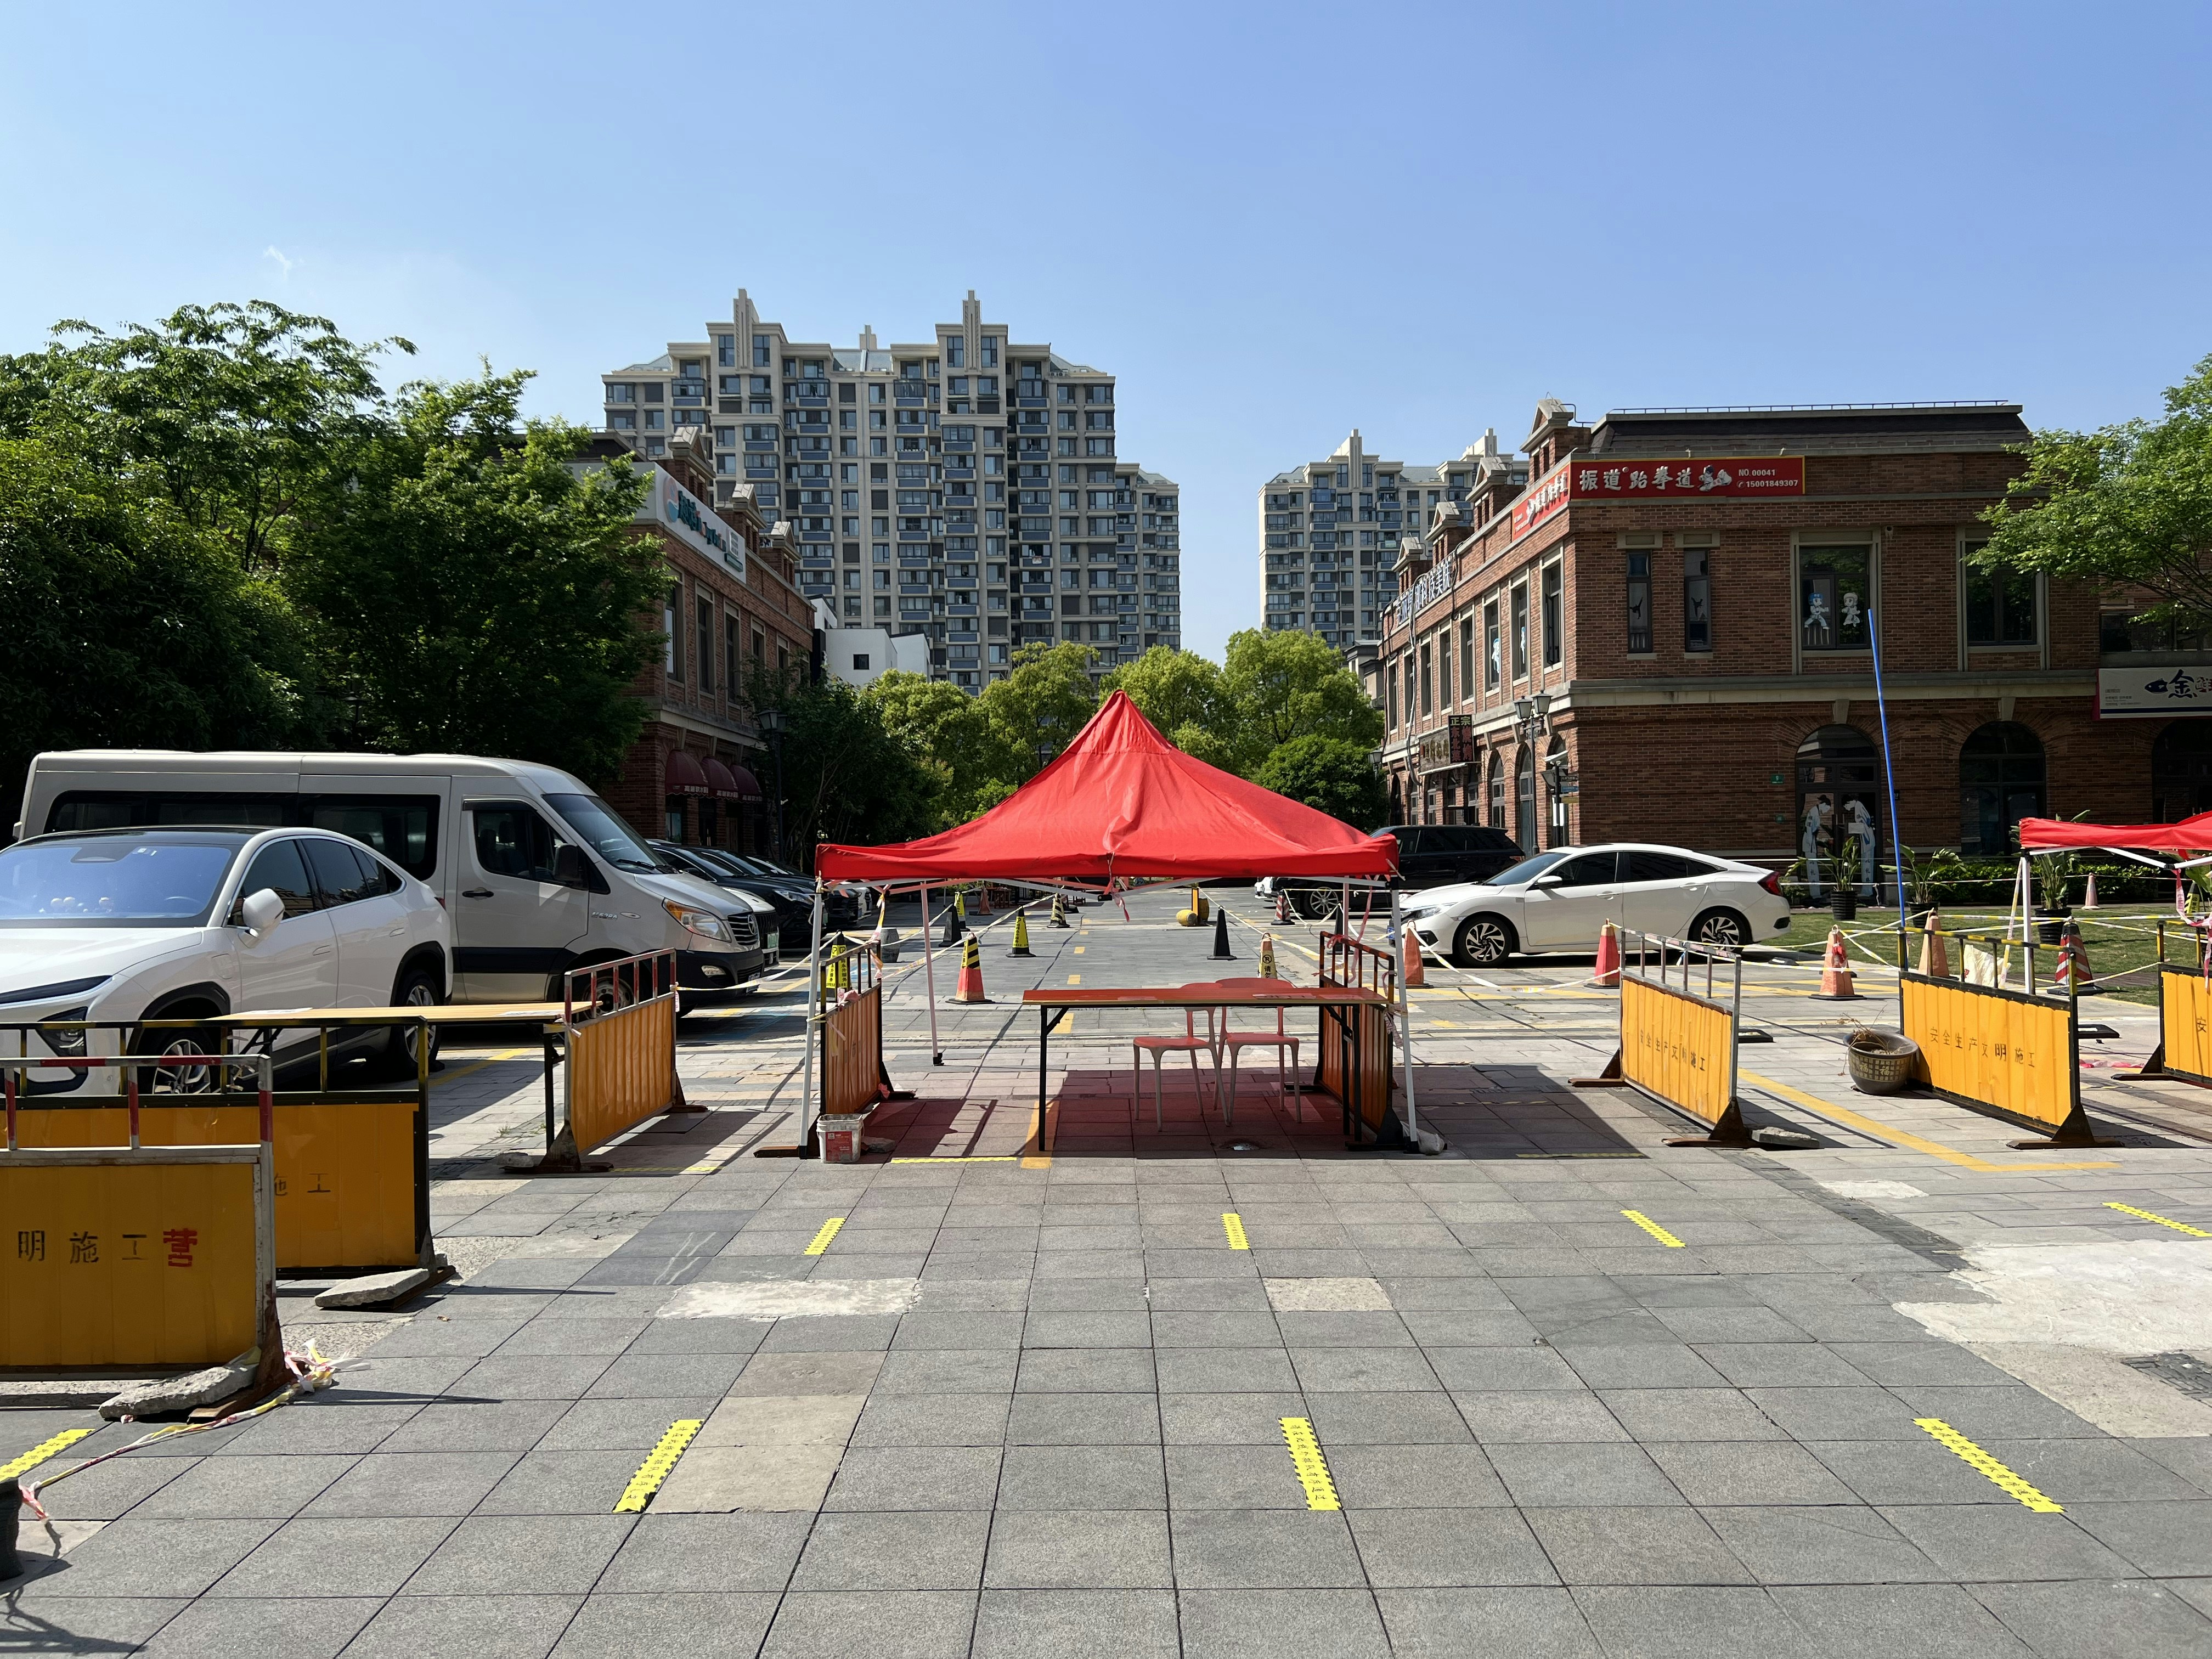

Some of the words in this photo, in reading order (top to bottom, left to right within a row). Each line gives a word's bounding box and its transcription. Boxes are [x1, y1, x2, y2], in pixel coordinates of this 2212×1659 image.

[1746, 479, 1798, 488] 15001849307
[1450, 716, 1471, 726] 正宗
[1929, 1026, 2035, 1068] 安全生产文明施工
[1880, 1065, 1890, 1075] 福
